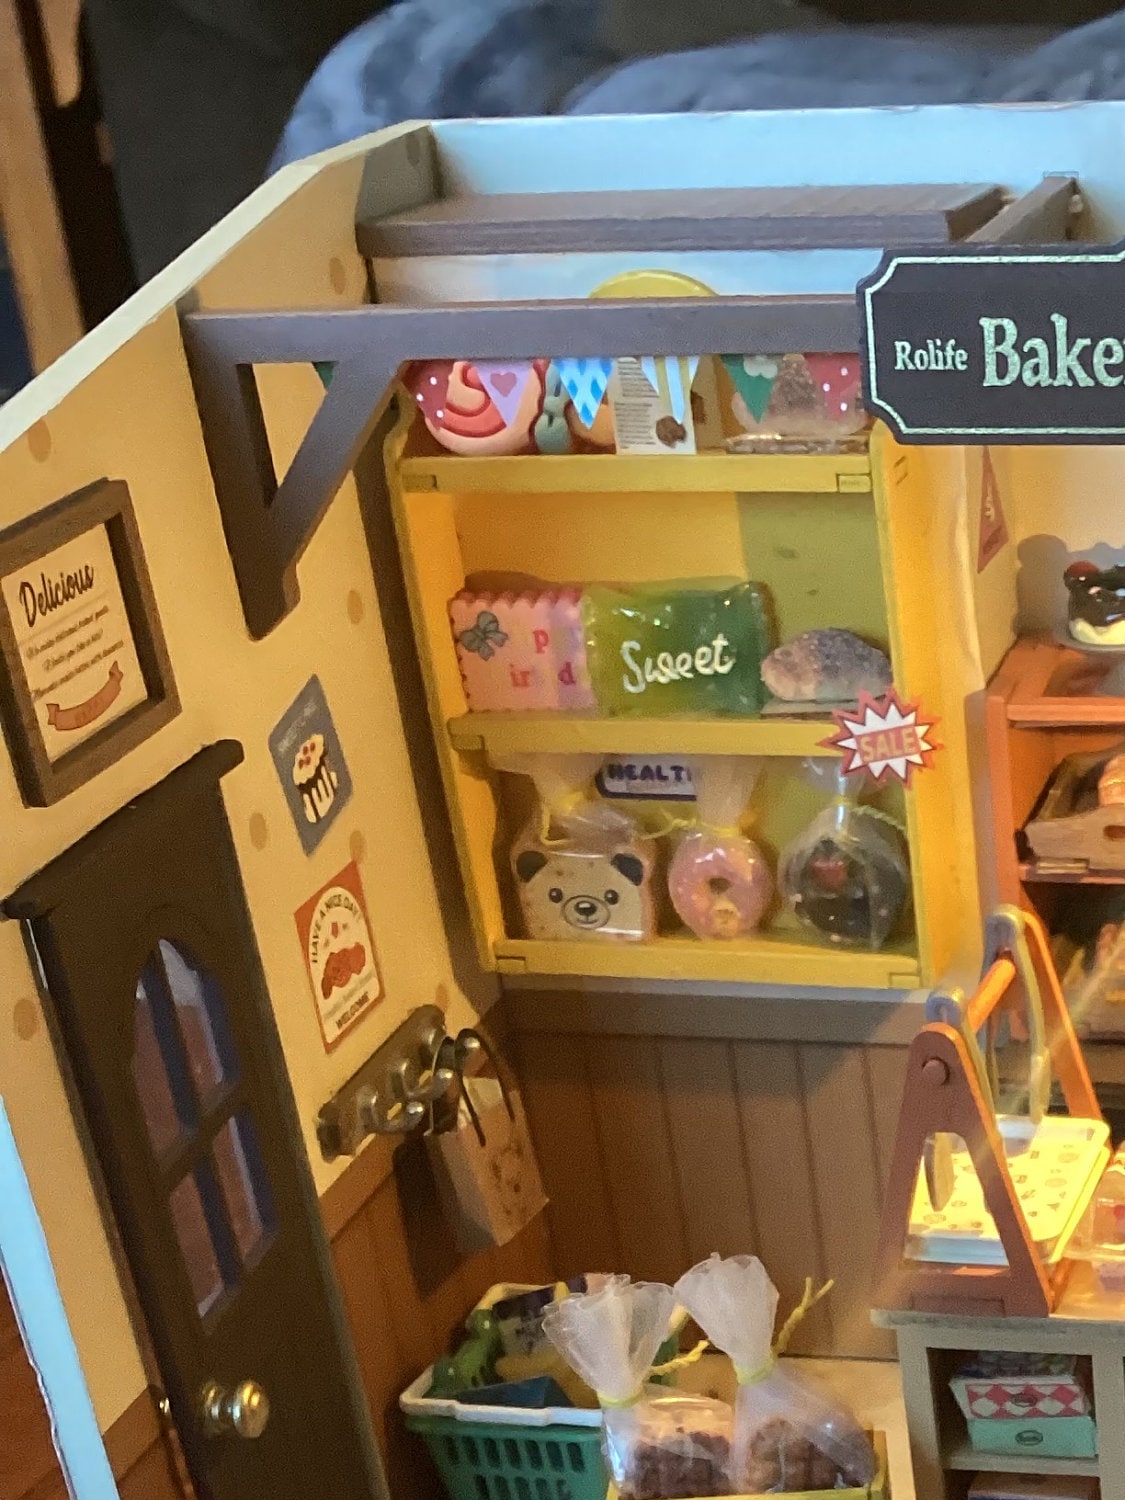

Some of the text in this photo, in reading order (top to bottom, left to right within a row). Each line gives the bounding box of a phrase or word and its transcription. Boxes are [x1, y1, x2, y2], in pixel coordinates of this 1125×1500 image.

[893, 338, 969, 371] Rolife
[18, 564, 95, 628] Delicious
[619, 633, 736, 694] Sweet
[860, 727, 917, 763] SALE
